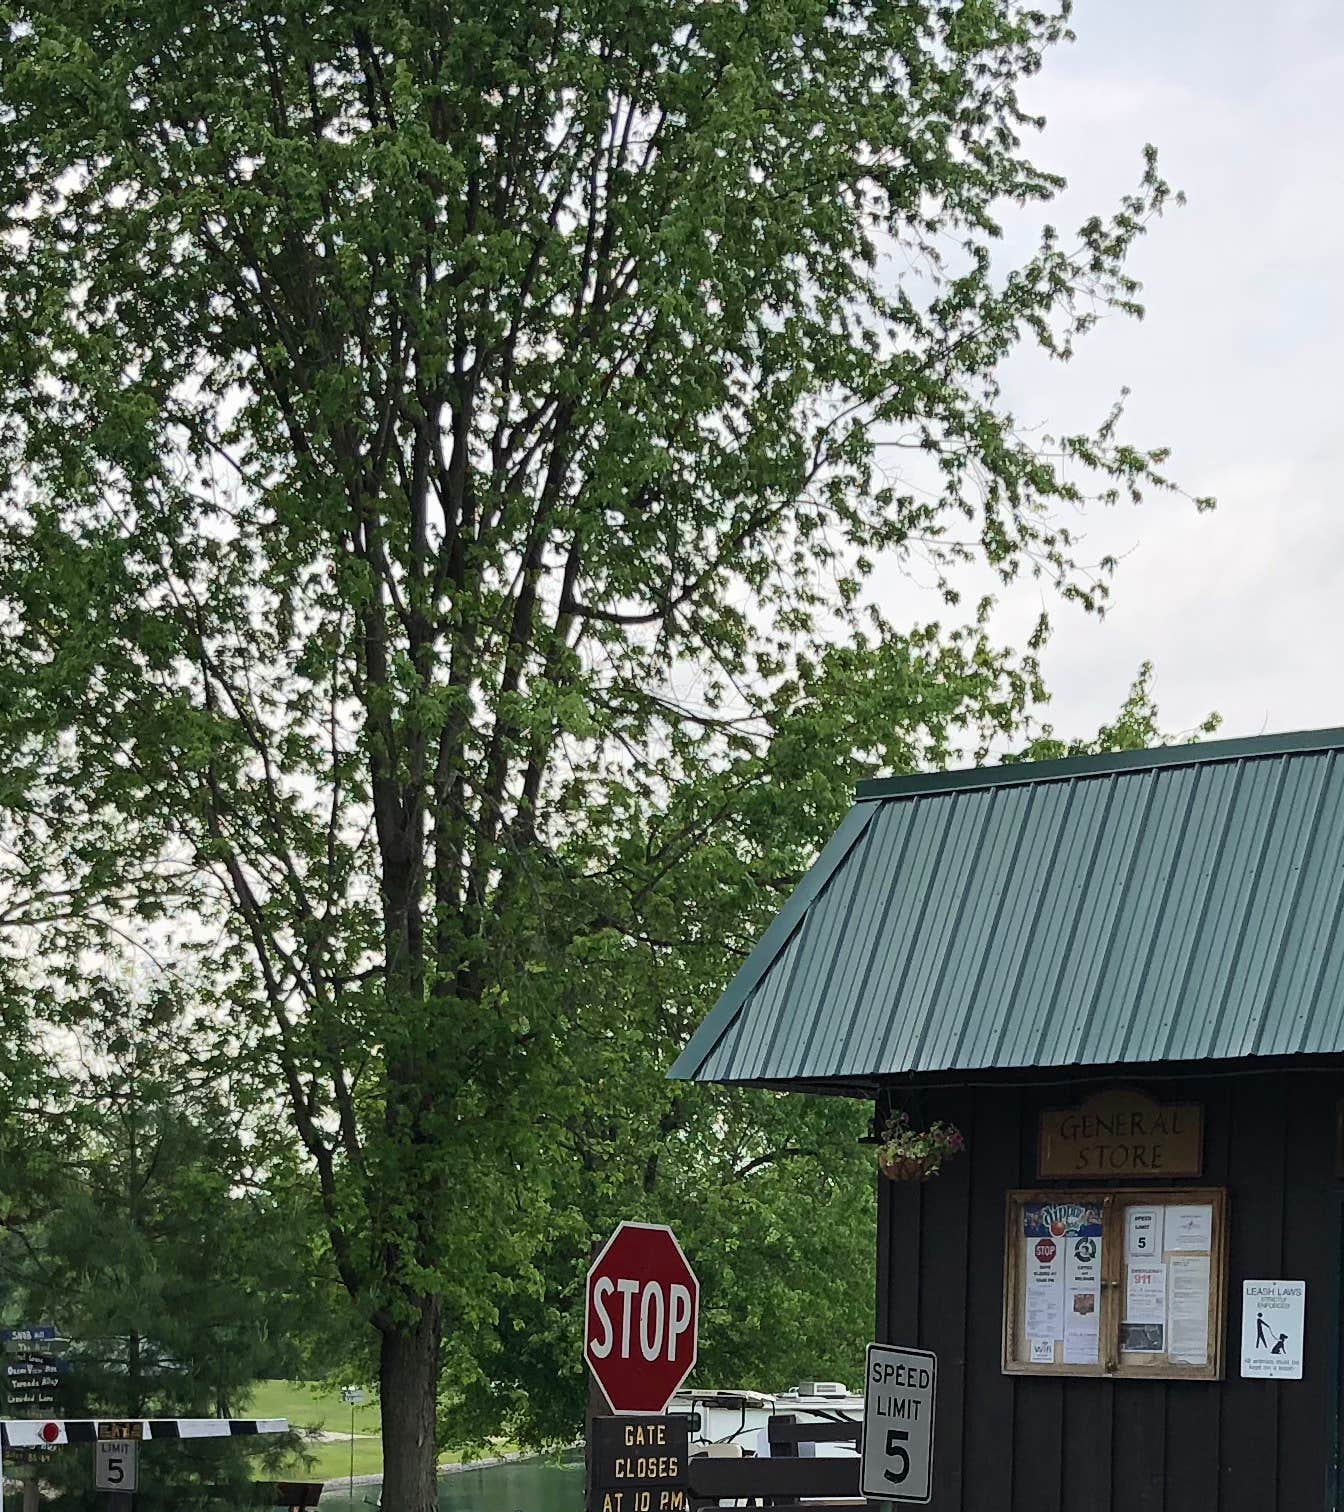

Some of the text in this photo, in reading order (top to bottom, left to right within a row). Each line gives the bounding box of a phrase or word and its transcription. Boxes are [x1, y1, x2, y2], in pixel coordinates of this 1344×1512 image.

[1060, 1111, 1184, 1140] GENERAL
[1075, 1144, 1163, 1170] STORE
[1037, 1245, 1056, 1256] STOP
[1137, 1237, 1146, 1249] 5
[1134, 1275, 1152, 1284] 911
[1246, 1287, 1302, 1297] LEASH LAWS
[590, 1276, 692, 1362] STOP
[872, 1362, 930, 1389] SPEED
[877, 1395, 922, 1421] LIMIT
[625, 1424, 666, 1446] GATE
[101, 1443, 130, 1455] LIMIT
[883, 1429, 910, 1484] 5
[108, 1458, 124, 1484] 5
[615, 1457, 678, 1478] CLOSES
[603, 1493, 623, 1512] AT
[634, 1491, 650, 1512] 10
